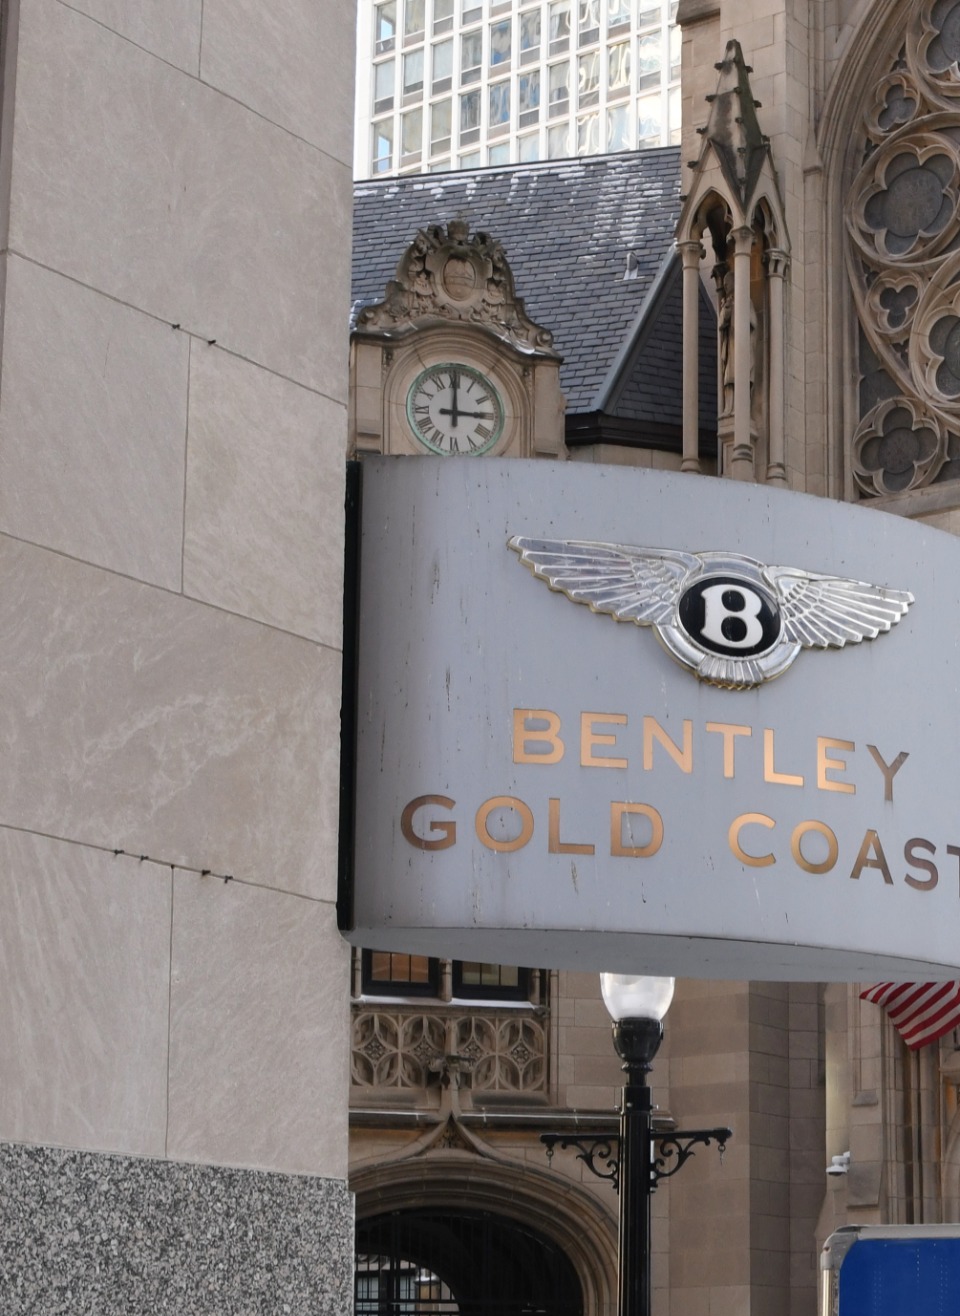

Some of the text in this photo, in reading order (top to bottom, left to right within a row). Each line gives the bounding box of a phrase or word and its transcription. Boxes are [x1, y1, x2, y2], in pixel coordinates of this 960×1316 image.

[700, 583, 764, 649] B
[513, 708, 910, 801] BENTLEY
[400, 794, 664, 858] GOLD
